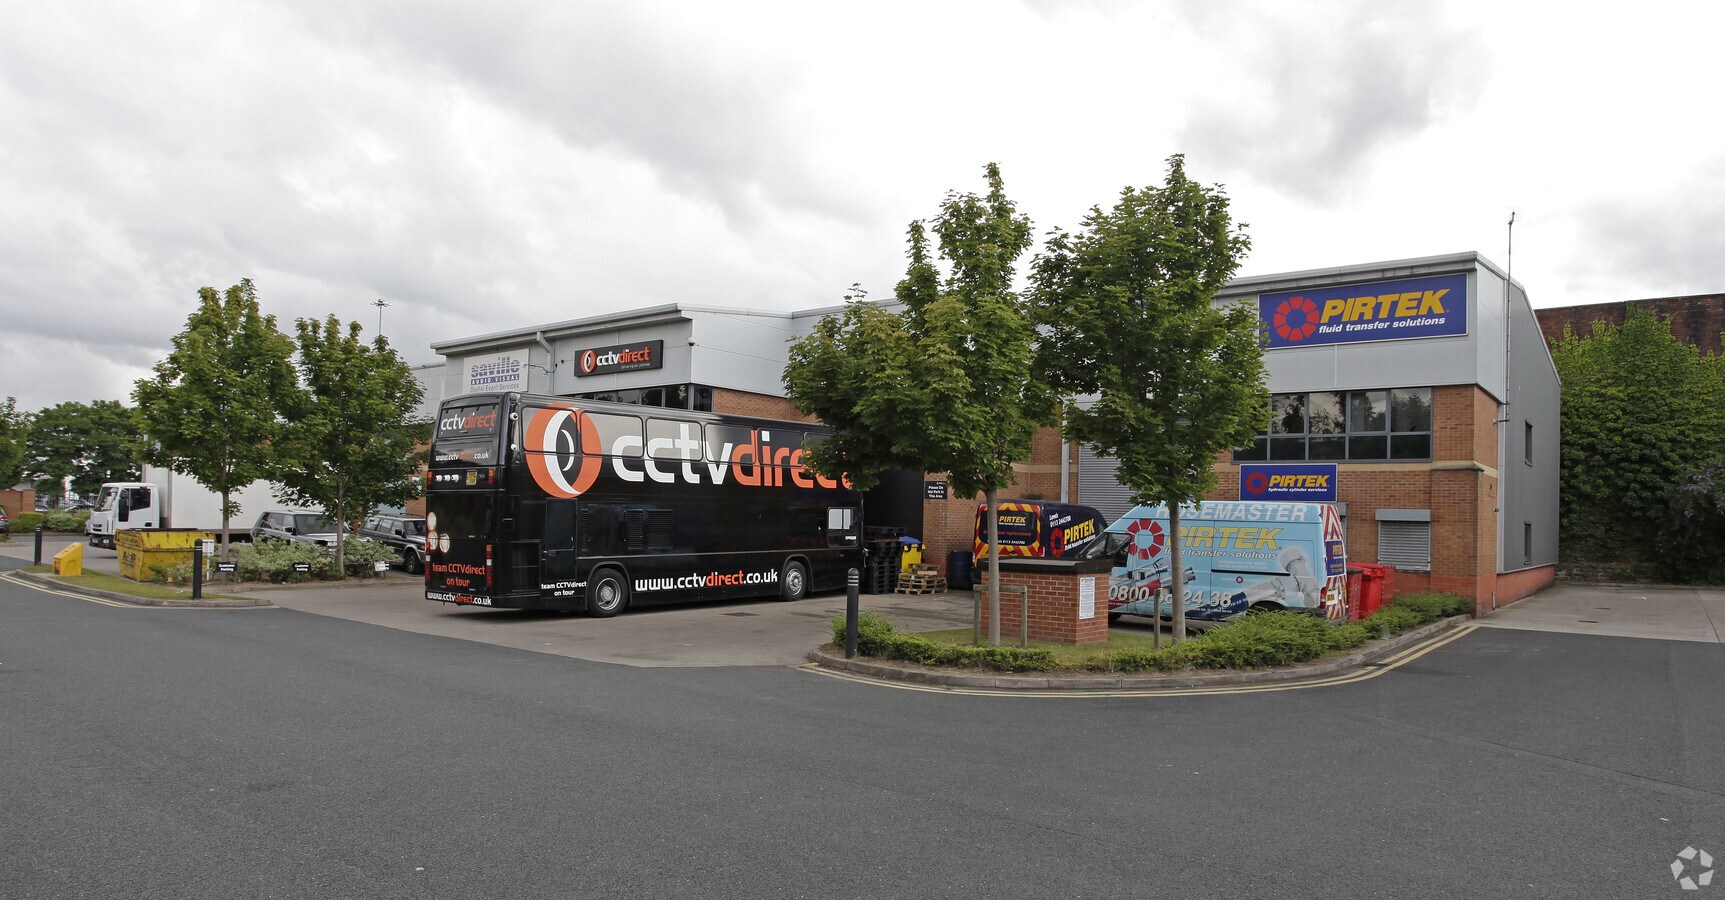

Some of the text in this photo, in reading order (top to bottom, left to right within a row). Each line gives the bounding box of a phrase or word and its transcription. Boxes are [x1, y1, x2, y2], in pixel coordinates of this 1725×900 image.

[1320, 288, 1450, 323] PIRTEK
[1319, 316, 1446, 334] fluid transfer solutions
[596, 346, 651, 366] cctvdirect
[471, 356, 520, 378] saville
[494, 374, 518, 382] VISUAL
[440, 410, 496, 430] cctvdirect
[611, 423, 854, 489] cctvdire
[1268, 475, 1330, 487] PIRTEK
[1000, 516, 1027, 524] PIRTEK
[1064, 518, 1095, 545] PIRTEK
[1165, 526, 1284, 550] PIRTEK
[1188, 549, 1226, 557] transfer
[1230, 551, 1278, 560] solutions
[432, 563, 485, 574] team CCTVdirect
[456, 577, 470, 586] tour
[634, 569, 778, 592] www.cctvdirect.co.uk
[428, 592, 492, 606] www.cctvdirect.co.uk
[1108, 585, 1150, 602] 0800
[1210, 591, 1232, 608] 38
